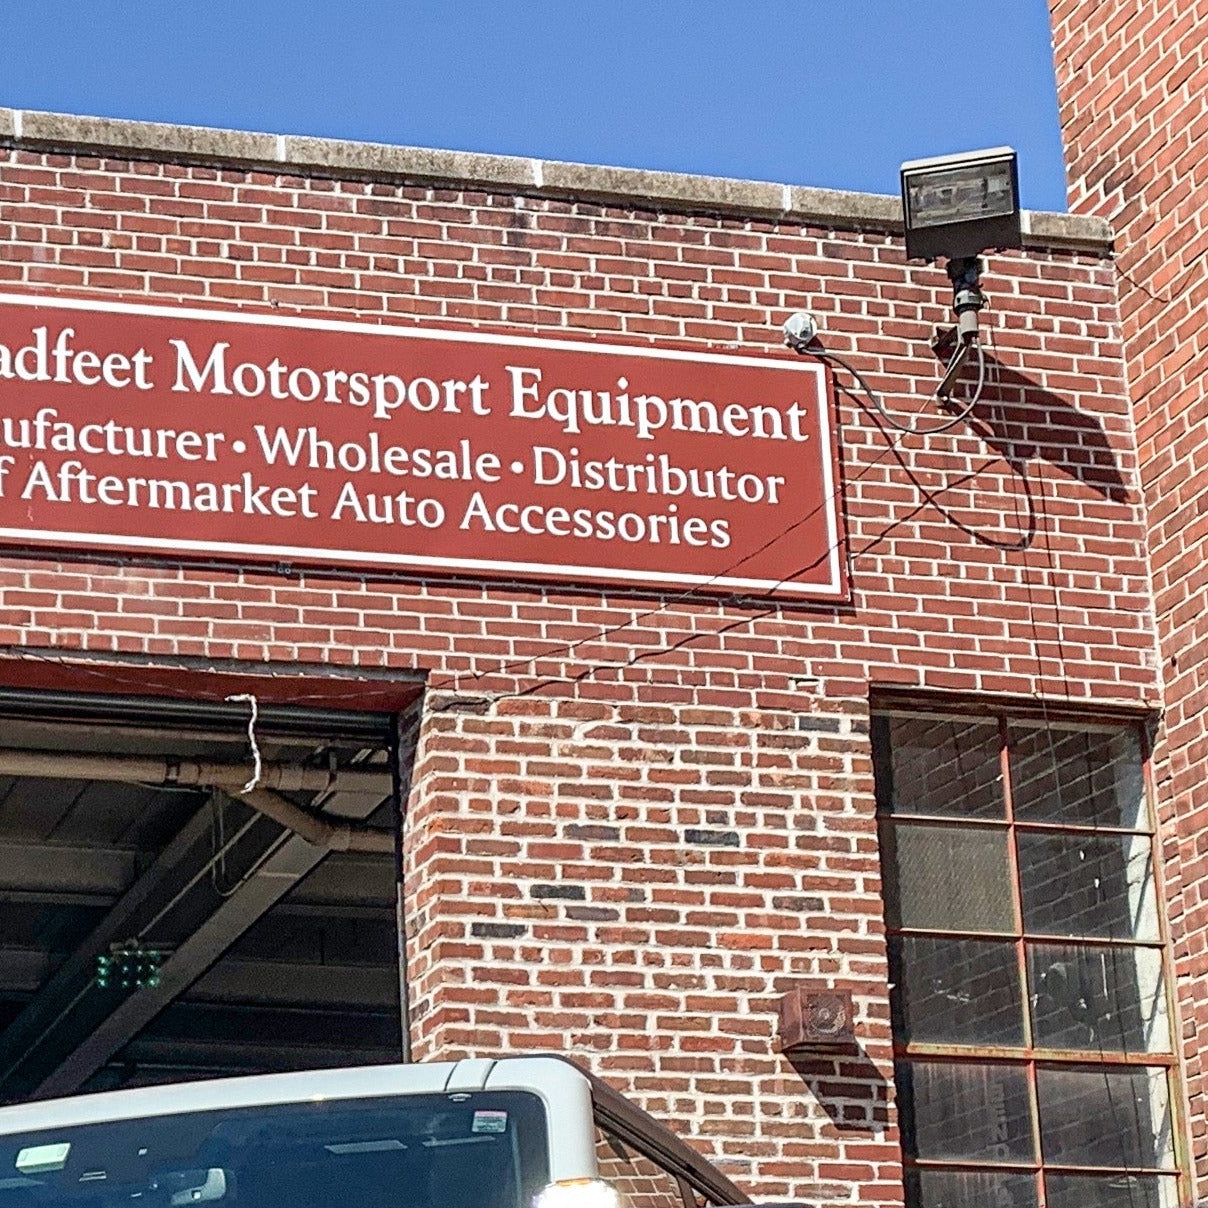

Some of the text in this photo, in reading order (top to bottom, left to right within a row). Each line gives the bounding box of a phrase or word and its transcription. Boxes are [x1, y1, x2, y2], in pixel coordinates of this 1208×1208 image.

[169, 340, 492, 419] Motorsport
[505, 366, 810, 443] Equipment
[21, 461, 319, 519] Aftermarket
[331, 482, 445, 528] Auto
[460, 492, 731, 548] Accessories
[254, 425, 501, 482] Wholesale
[533, 446, 785, 504] Distributor
